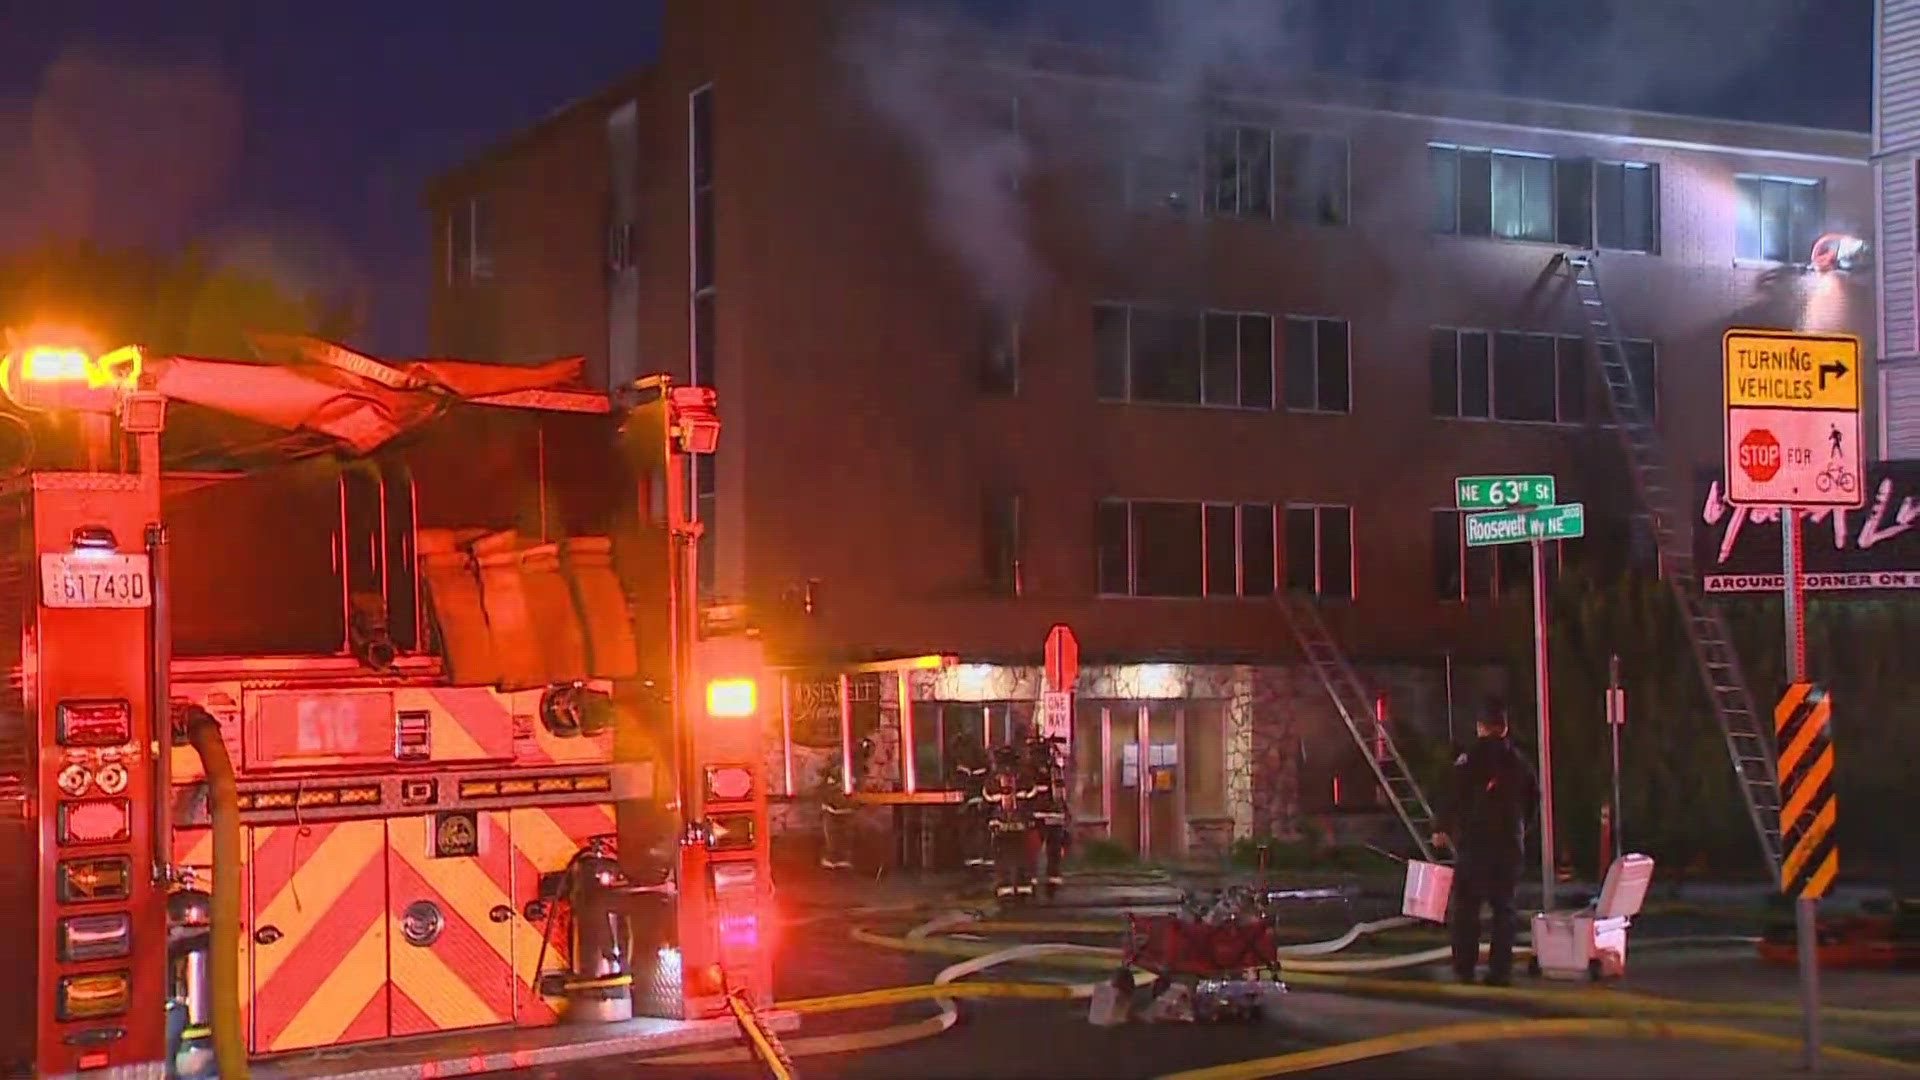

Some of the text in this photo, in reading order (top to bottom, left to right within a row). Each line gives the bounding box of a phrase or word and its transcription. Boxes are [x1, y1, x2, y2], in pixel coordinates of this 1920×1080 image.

[1738, 348, 1812, 372] TURNING
[1738, 377, 1813, 399] VEHICLES
[1741, 445, 1811, 466] STOP FOR
[1461, 480, 1550, 504] NE 63rd St
[1469, 514, 1565, 540] Roosevelt Wy NE
[1710, 574, 1785, 589] AROUND
[1802, 573, 1871, 588] ORNER
[1879, 573, 1906, 586] ON
[1047, 696, 1067, 711] ONE
[1047, 713, 1067, 727] WAY
